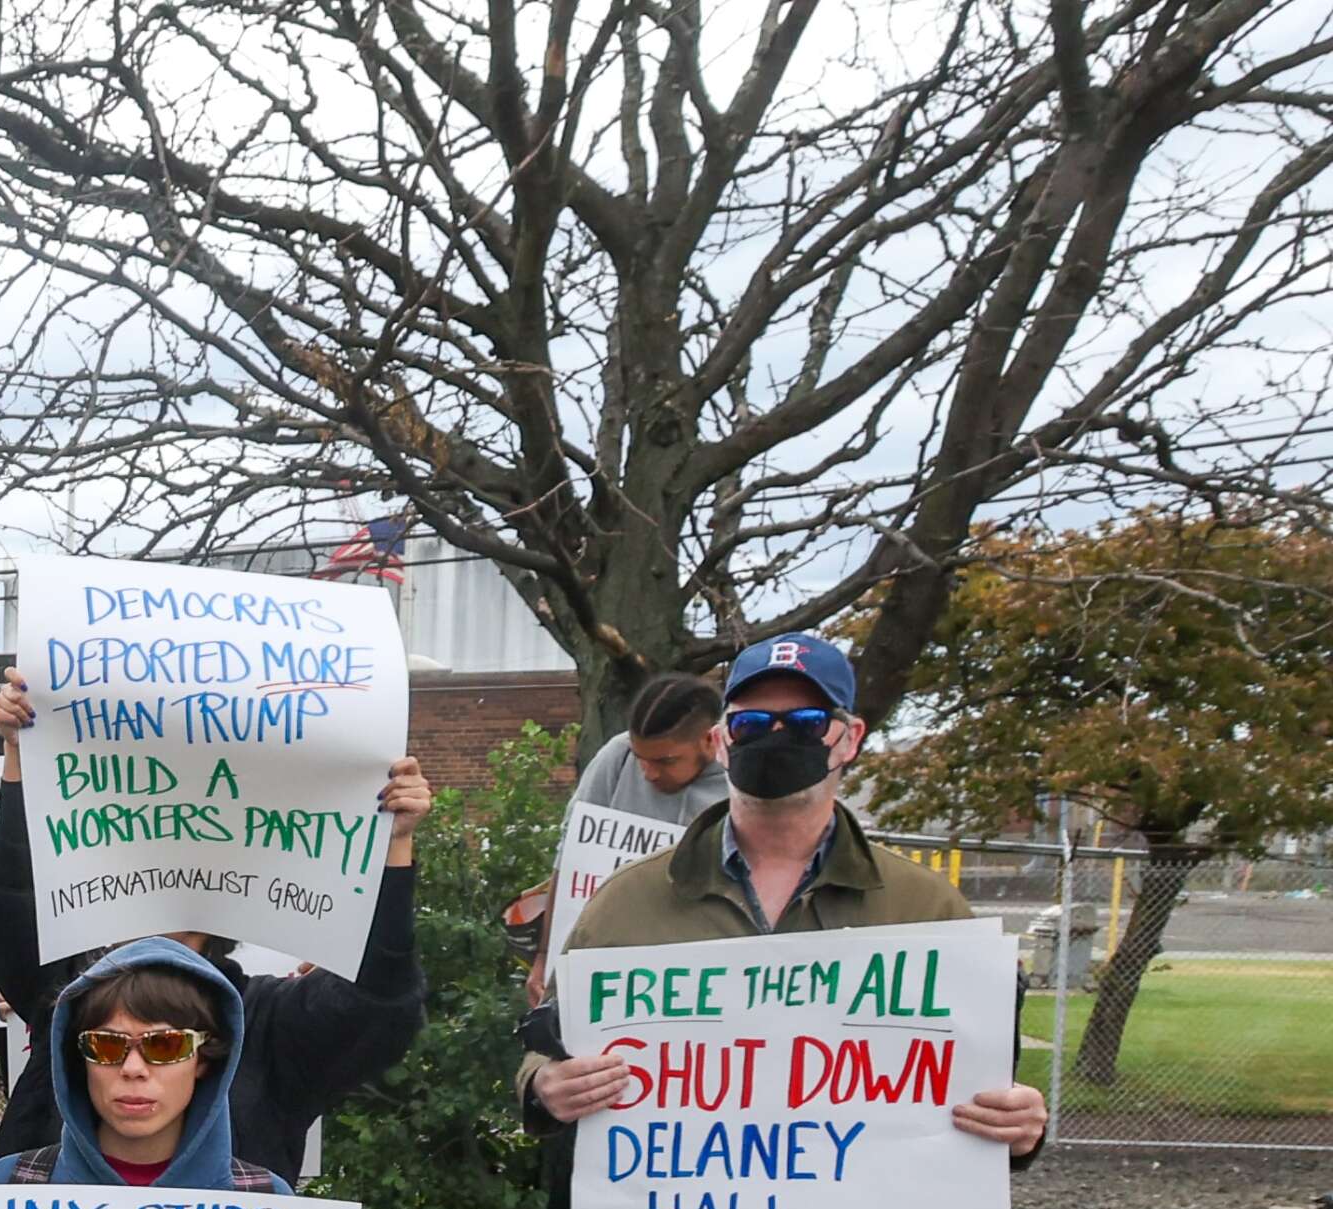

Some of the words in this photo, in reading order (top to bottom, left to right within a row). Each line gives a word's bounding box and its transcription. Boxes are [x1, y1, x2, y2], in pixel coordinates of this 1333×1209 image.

[84, 586, 344, 633] DEMOCRATS
[48, 637, 251, 691] DEPORTED
[262, 641, 374, 686] MORE
[53, 697, 165, 743] THAN
[172, 691, 328, 744] TRUMP
[56, 752, 178, 801] BUILD
[206, 758, 239, 800] A
[46, 803, 234, 857] WORKERS
[244, 806, 378, 895] PARTY!
[51, 867, 258, 917] INTERNATIONALIST
[268, 878, 334, 920] GROUP
[589, 967, 728, 1023] FREE
[743, 960, 841, 1009] THEM
[847, 949, 951, 1017] ALL
[601, 1037, 766, 1111] SHUT
[787, 1035, 954, 1107] DOWN
[607, 1121, 865, 1182] DELANEY
